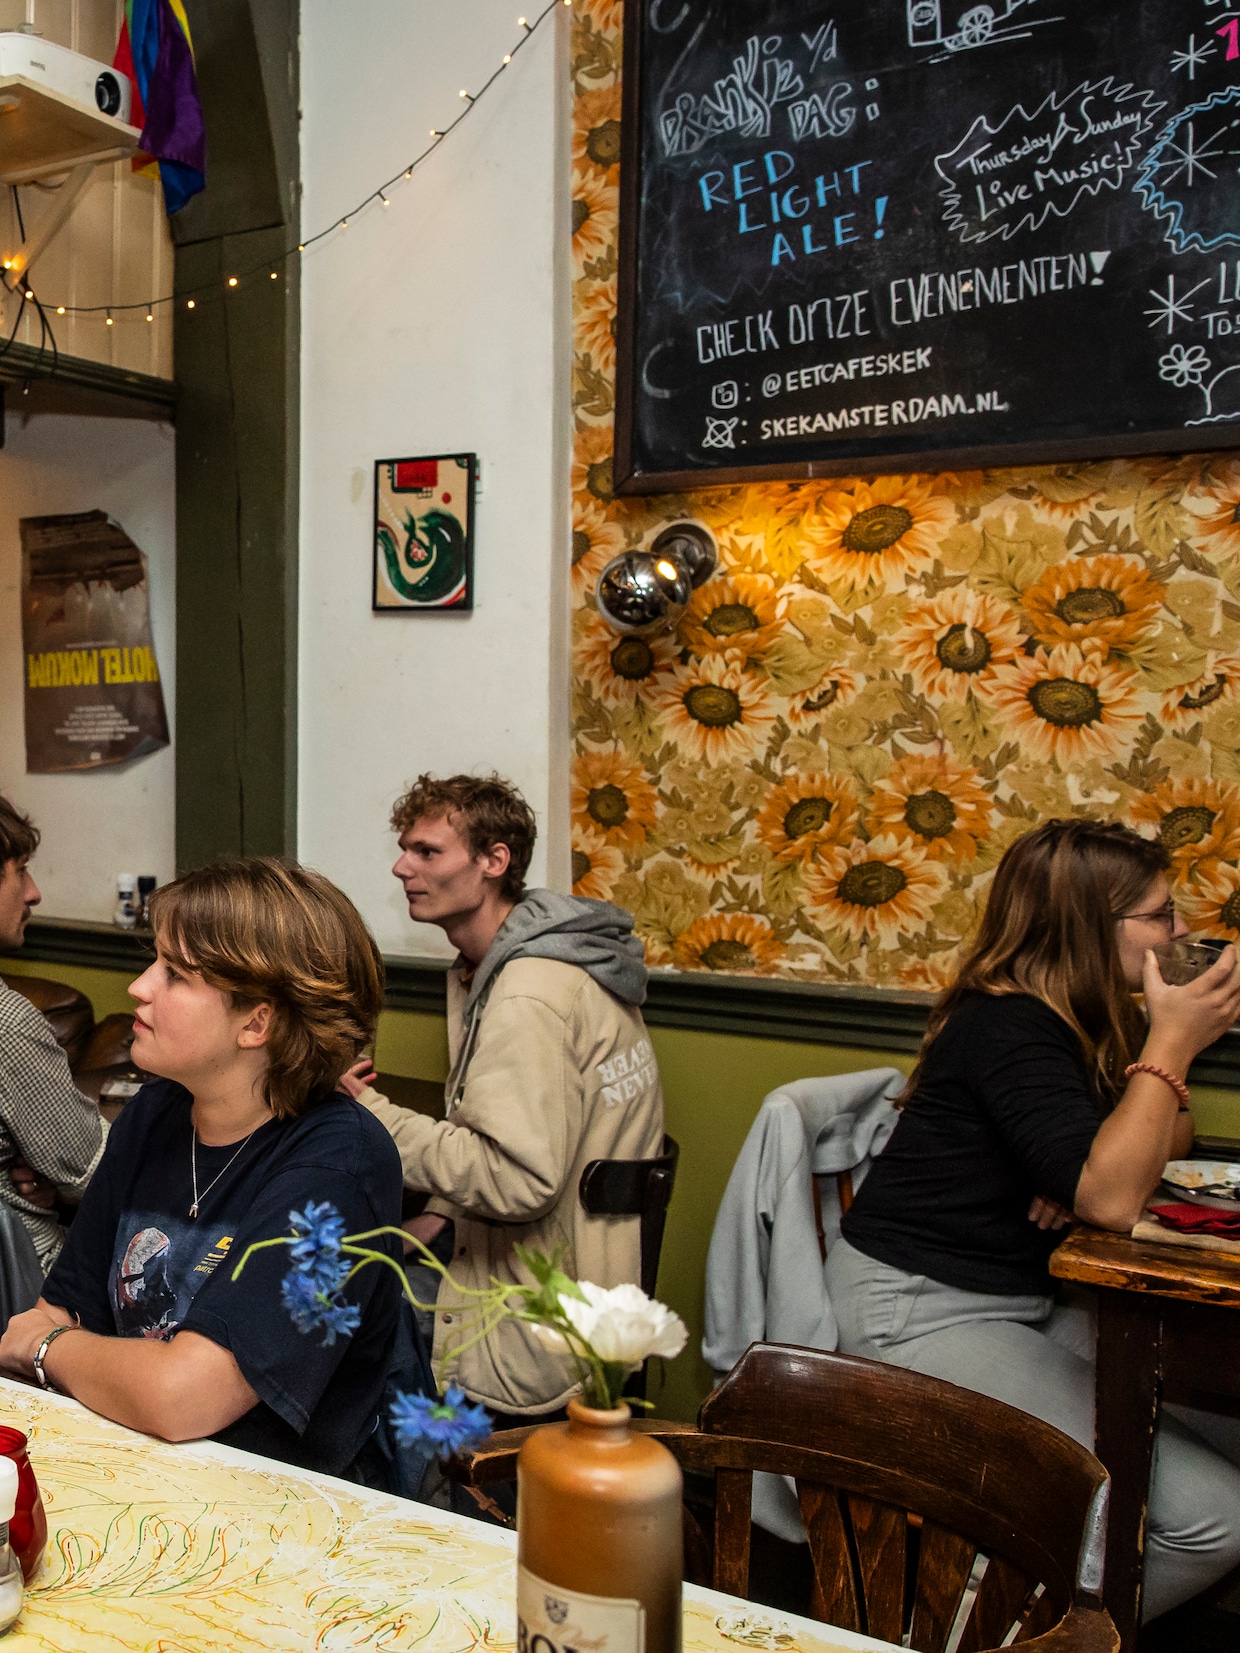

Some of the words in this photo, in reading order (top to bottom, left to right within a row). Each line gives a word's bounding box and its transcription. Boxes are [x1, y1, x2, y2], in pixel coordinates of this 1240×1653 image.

[1073, 96, 1142, 145] Sunday
[698, 150, 796, 213] RED
[738, 159, 873, 235] LIGHT
[975, 179, 1033, 222] Live
[696, 309, 780, 365] CHECK
[889, 249, 1112, 326] EVENEMENTEN!
[760, 389, 1009, 440] SKEKAMSTERDAM.NL
